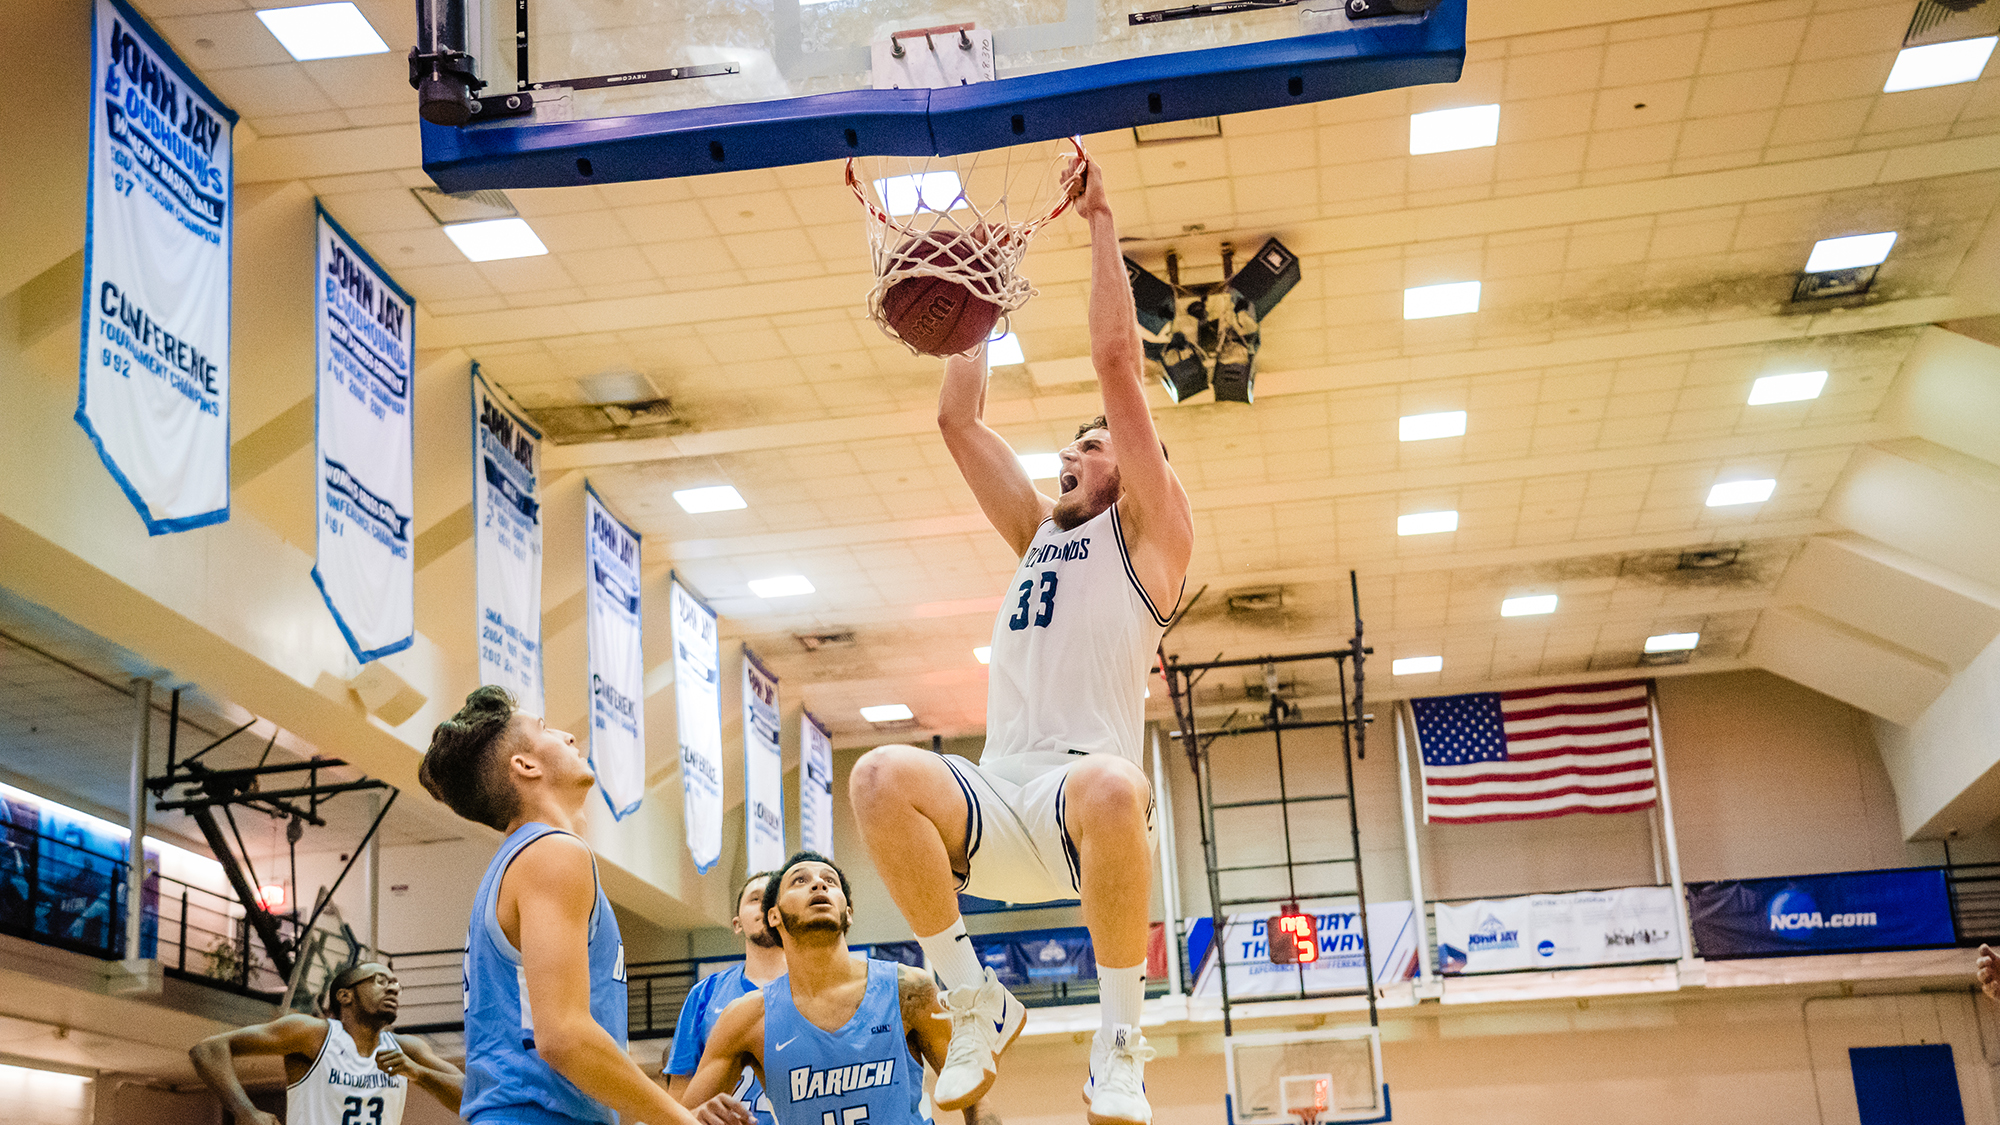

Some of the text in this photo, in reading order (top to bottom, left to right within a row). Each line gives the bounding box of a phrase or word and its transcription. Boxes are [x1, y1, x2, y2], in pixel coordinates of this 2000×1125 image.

[111, 17, 221, 162] JOHN JAY
[161, 160, 219, 222] BASKETBALL
[329, 237, 404, 342] JOHN JAY
[1009, 571, 1058, 631] 33
[1770, 912, 1877, 931] NCAA.com
[790, 1058, 895, 1103] BARUCH
